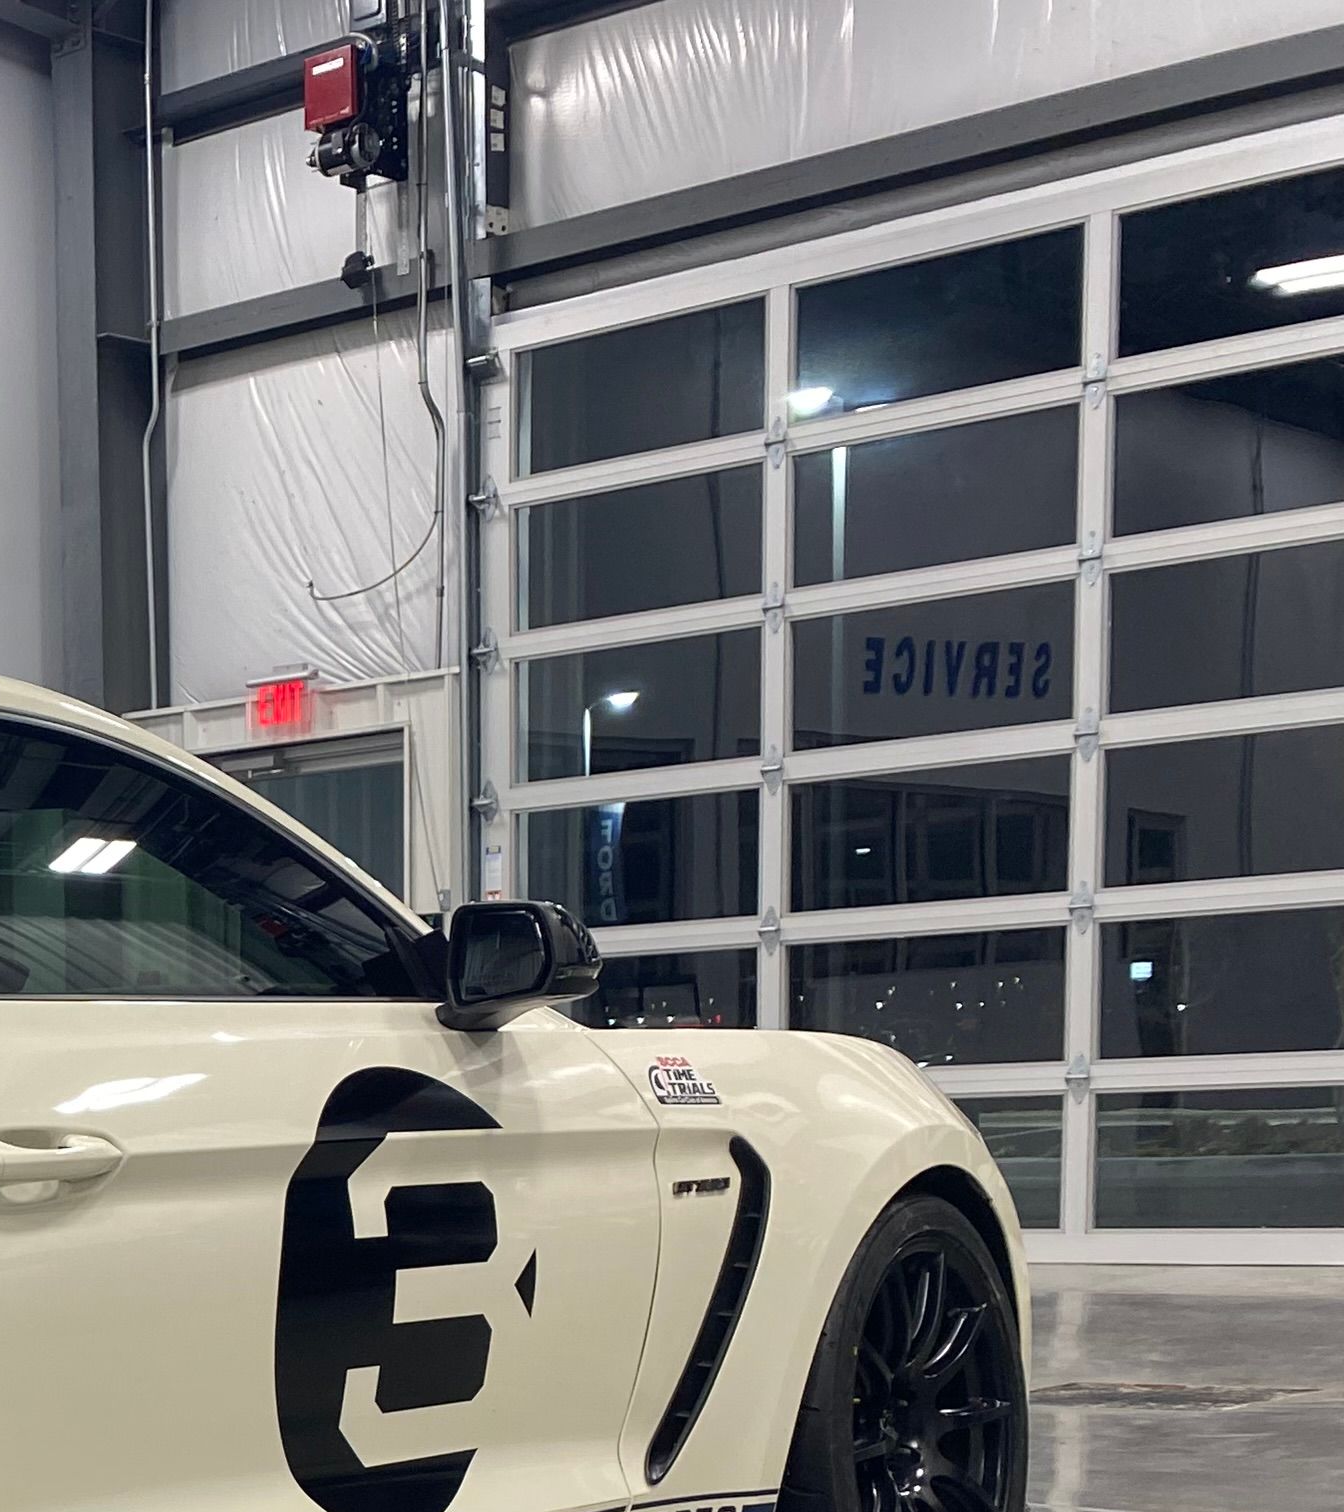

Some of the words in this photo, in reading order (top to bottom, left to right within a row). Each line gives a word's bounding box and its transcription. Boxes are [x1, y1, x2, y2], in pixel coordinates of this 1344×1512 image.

[258, 680, 304, 726] EXIT
[663, 1069, 697, 1081] TIME
[668, 1083, 716, 1095] TRIALS
